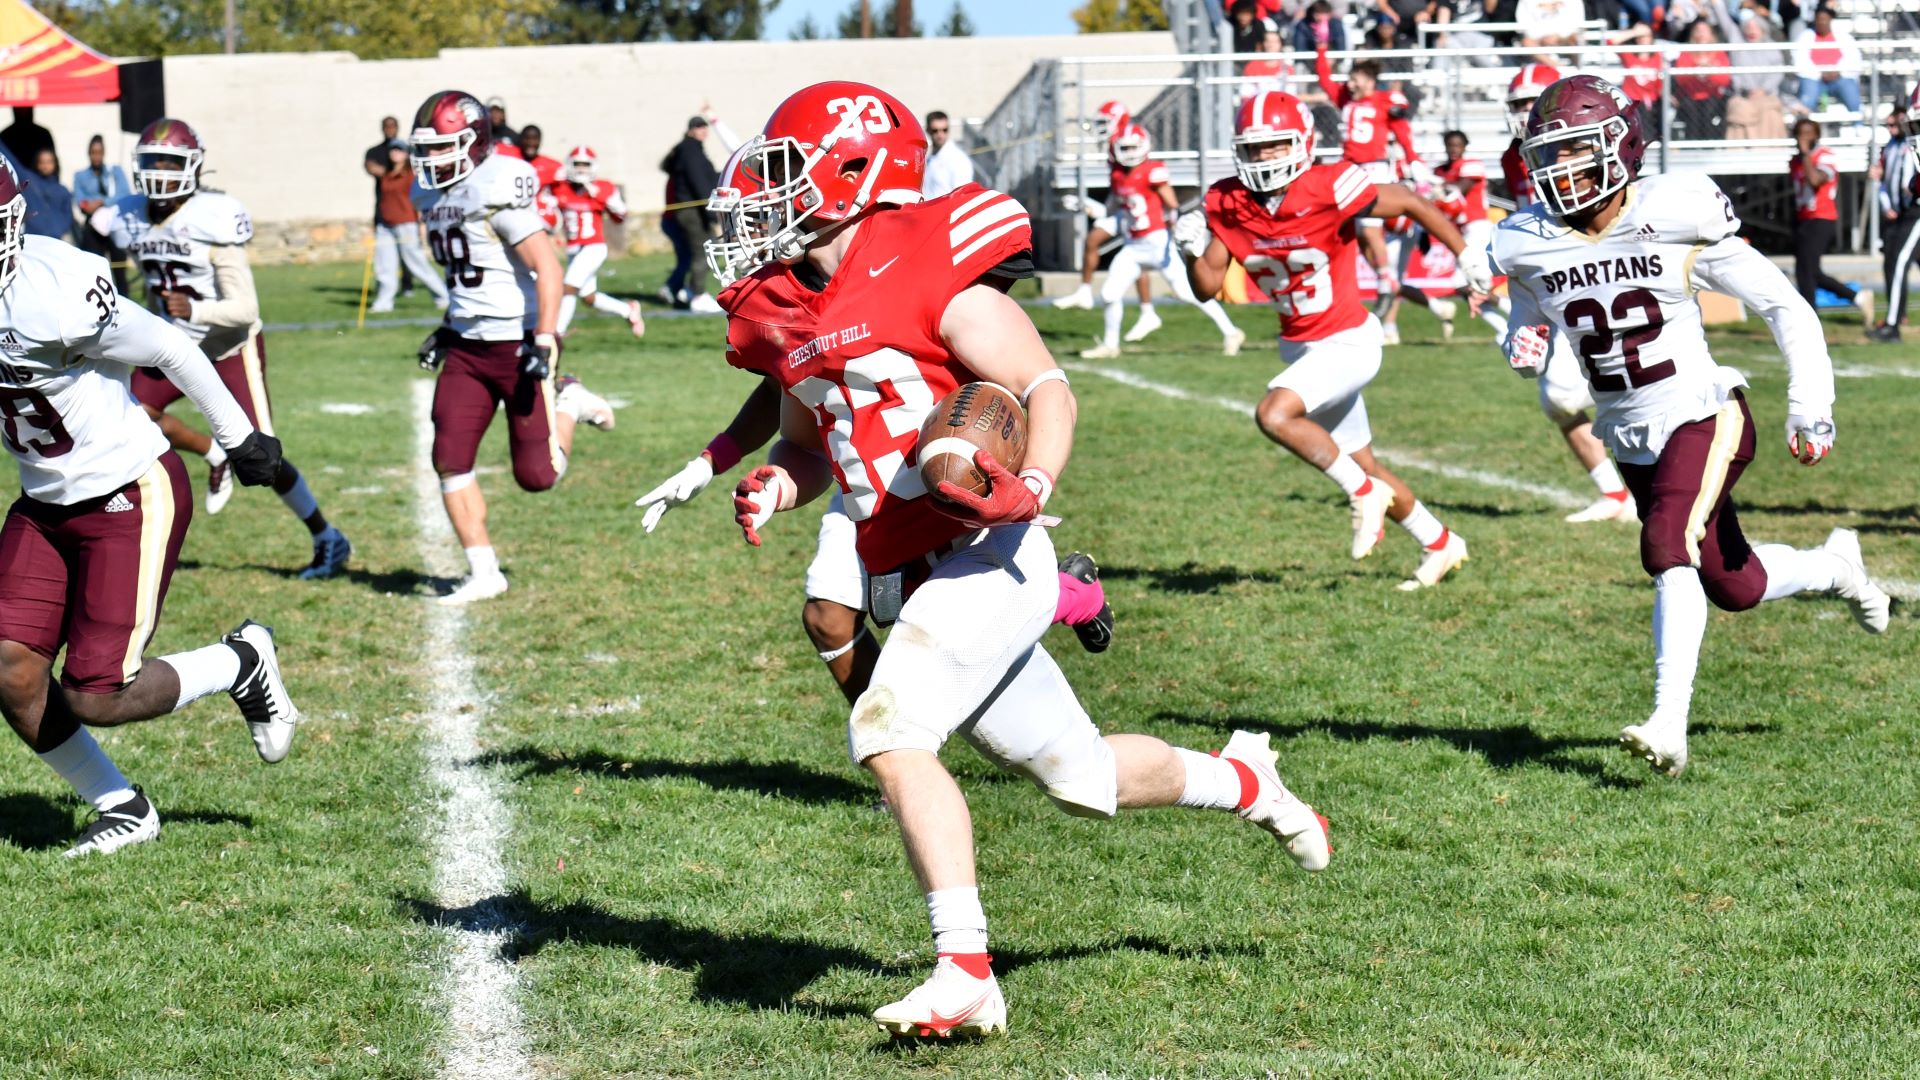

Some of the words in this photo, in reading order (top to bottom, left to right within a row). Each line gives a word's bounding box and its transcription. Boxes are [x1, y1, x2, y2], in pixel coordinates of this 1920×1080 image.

[826, 95, 892, 139] 33
[514, 175, 535, 199] 98
[1243, 247, 1334, 317] 23
[1541, 254, 1663, 294] SPARTANS
[86, 275, 117, 323] 39
[787, 332, 838, 369] CHESTNUT
[840, 323, 872, 346] HILL
[1564, 288, 1677, 392] 22
[974, 395, 1003, 432] Wilson
[104, 503, 134, 513] adidas
